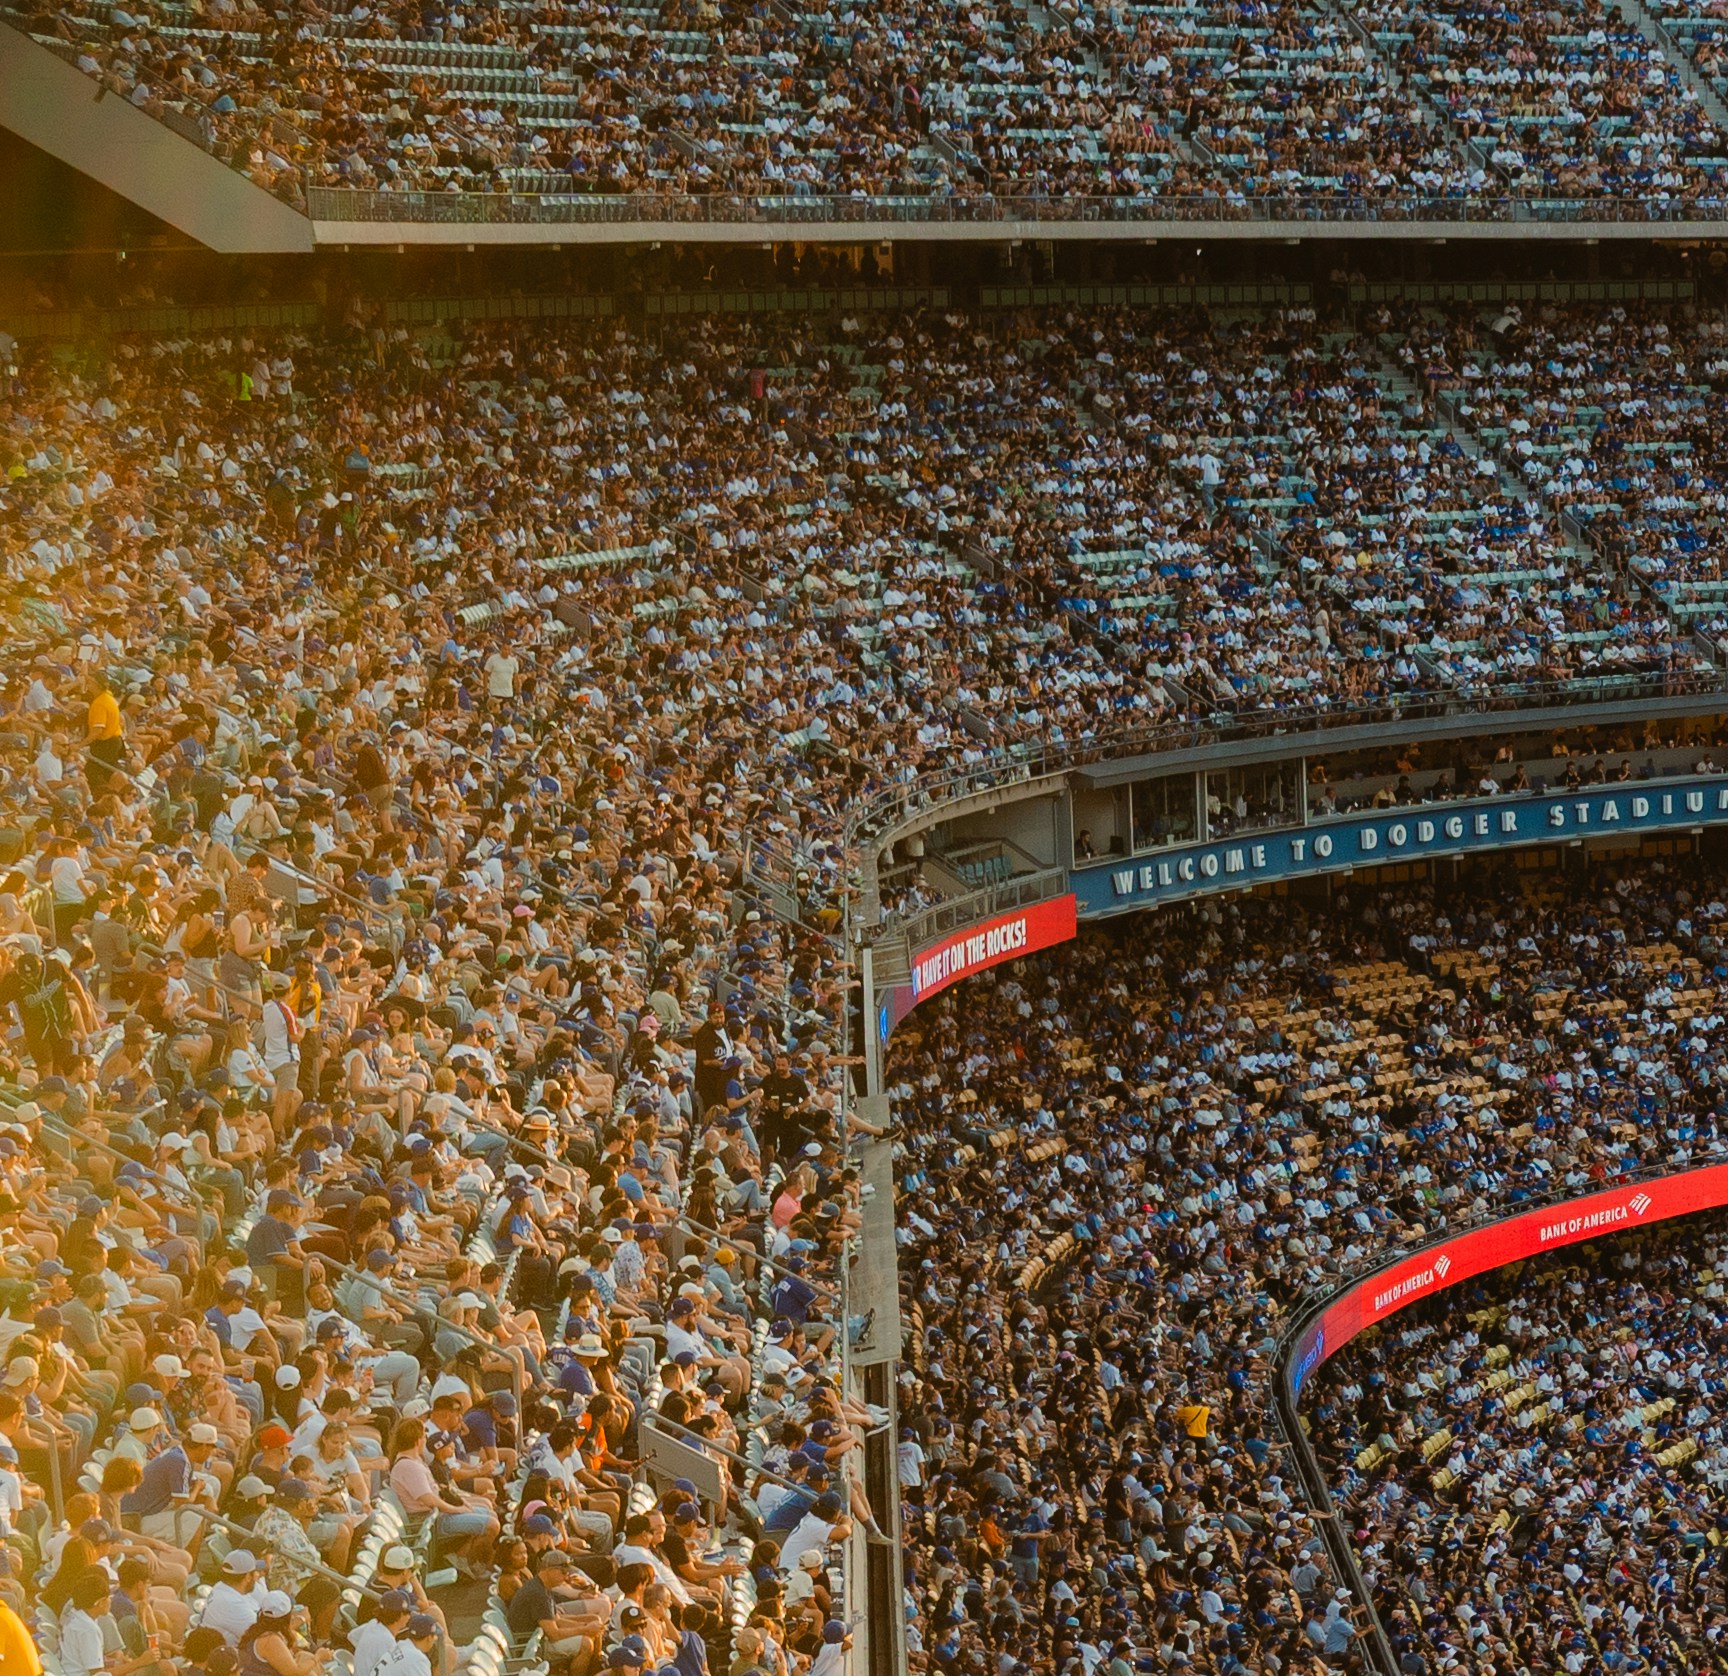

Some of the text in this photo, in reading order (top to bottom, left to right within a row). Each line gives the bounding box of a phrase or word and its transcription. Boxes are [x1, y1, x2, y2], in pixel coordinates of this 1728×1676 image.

[1113, 845, 1266, 894] WELCOME
[1292, 834, 1332, 861] TO
[1361, 811, 1517, 850] DODGER
[922, 955, 943, 990] HAVE
[943, 949, 951, 978] IT
[951, 942, 966, 973] ON
[966, 933, 985, 966] THE
[987, 918, 1027, 957] ROCKS!
[1541, 1206, 1627, 1241] BANK OF AMERICA
[1375, 1270, 1434, 1310] BANK OF AMERICA
